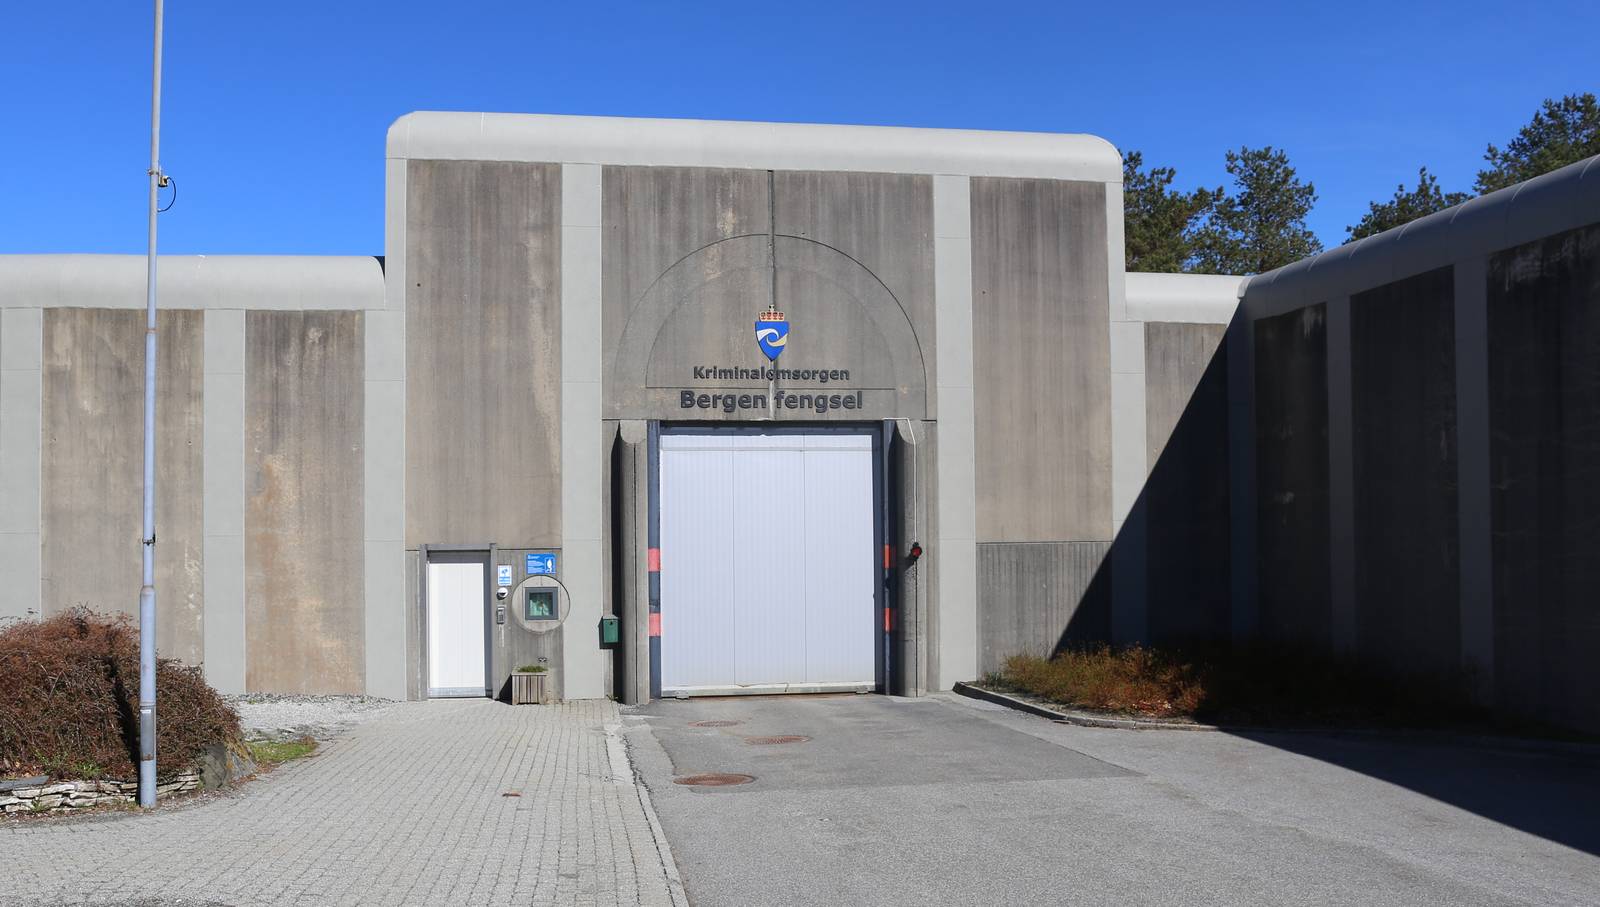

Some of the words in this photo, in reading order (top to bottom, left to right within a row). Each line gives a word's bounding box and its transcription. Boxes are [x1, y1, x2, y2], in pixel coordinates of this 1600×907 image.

[693, 366, 850, 383] Kriminalomsorgen
[680, 390, 767, 412] Bergen
[774, 391, 863, 413] fengsel
